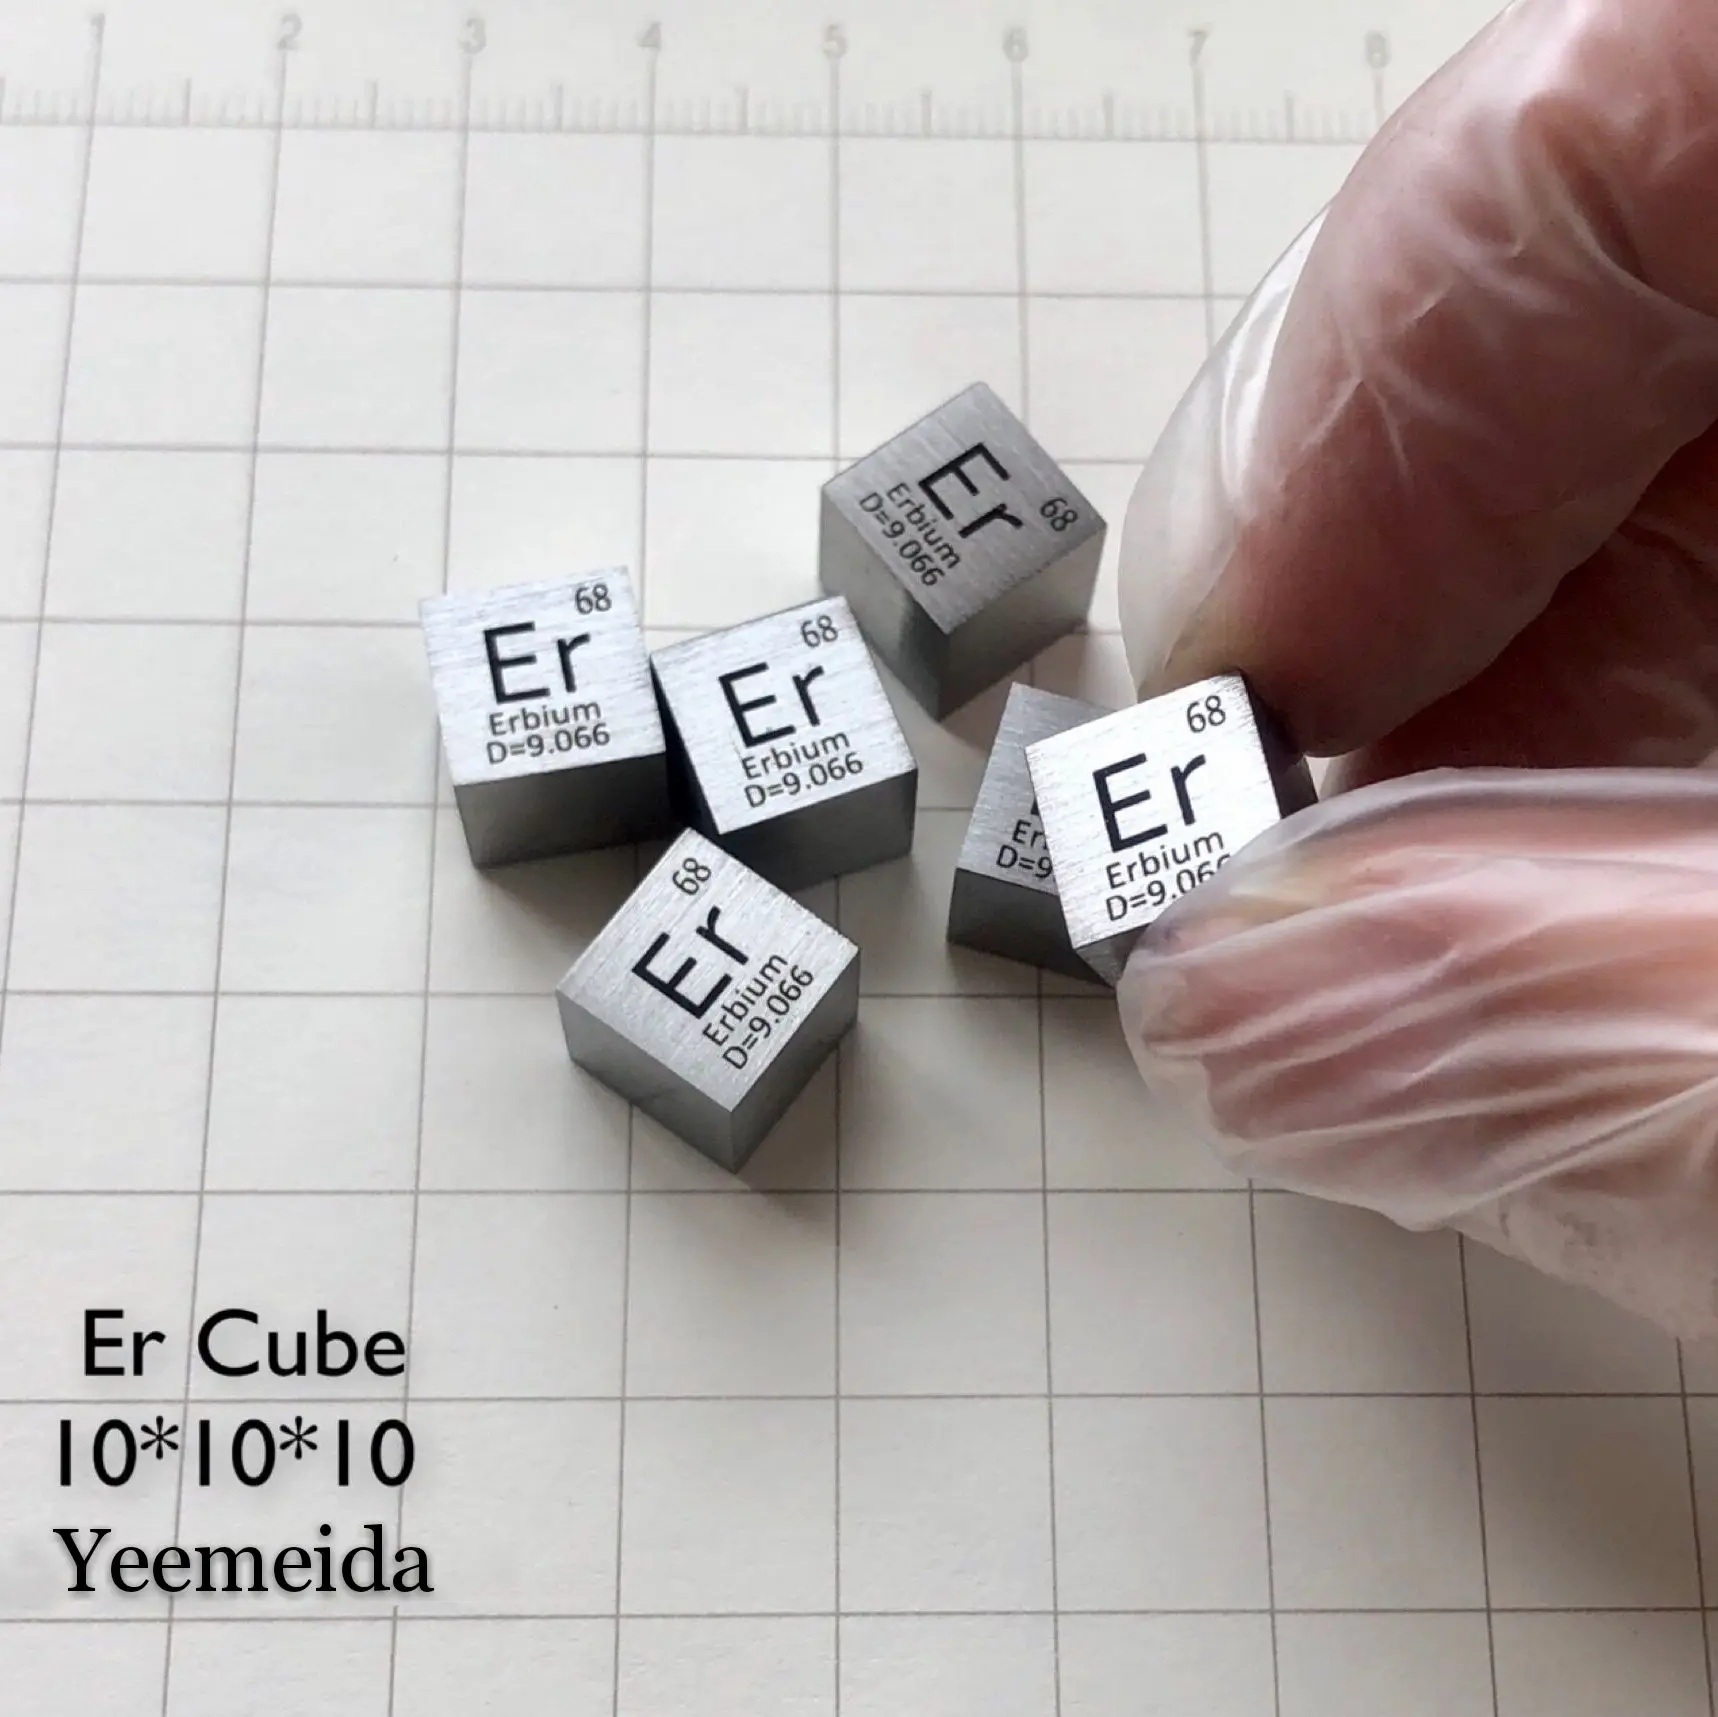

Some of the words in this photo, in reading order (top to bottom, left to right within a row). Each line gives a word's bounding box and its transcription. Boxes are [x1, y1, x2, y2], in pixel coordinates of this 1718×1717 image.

[90, 12, 106, 48] 1
[276, 12, 303, 51] 2
[459, 16, 487, 54] 3
[637, 20, 662, 50] 4
[822, 23, 848, 60] 5
[1002, 26, 1029, 62] 6
[1186, 28, 1211, 67] 7
[1364, 30, 1392, 69] 8
[918, 442, 1024, 538] Er
[1039, 497, 1078, 532] 68
[860, 493, 946, 586] D=9.066
[887, 482, 961, 569] Erbium
[574, 584, 612, 615] 68
[800, 615, 839, 649] 68
[483, 621, 592, 704] Er
[488, 701, 602, 737] Erbium
[718, 662, 825, 749] Er
[1186, 695, 1226, 733] 68
[486, 725, 610, 766] D=9.066
[741, 730, 851, 780] Erbium
[745, 752, 865, 810] D=9.066
[1093, 753, 1206, 853] Er
[673, 857, 711, 895] 68
[1106, 832, 1224, 889] Erbium
[631, 906, 748, 1020] Er
[702, 954, 788, 1046] Erbium
[723, 964, 814, 1069] D=9.066
